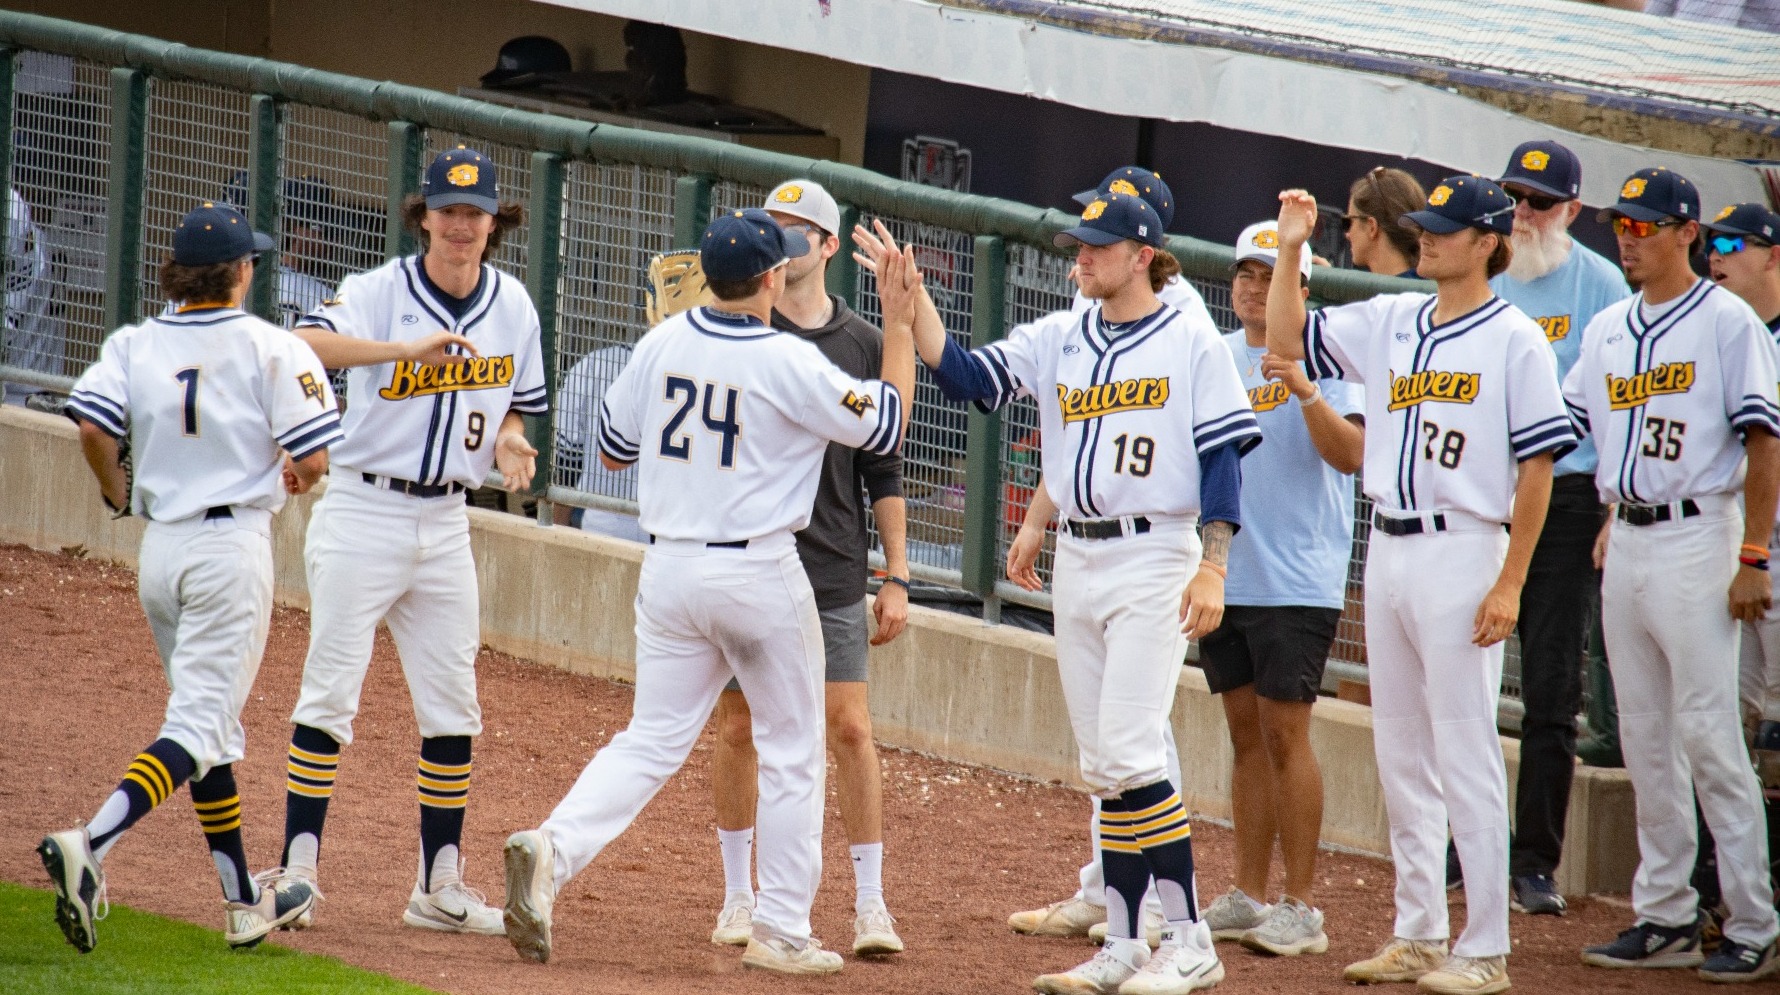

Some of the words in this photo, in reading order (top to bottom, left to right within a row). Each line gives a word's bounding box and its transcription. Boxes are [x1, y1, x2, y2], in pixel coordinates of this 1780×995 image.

[378, 354, 515, 401] Beavers
[1387, 368, 1482, 413] eavers
[1605, 360, 1697, 411] eaers
[172, 366, 201, 437] 1
[657, 372, 743, 471] 24
[465, 411, 485, 452] 9
[1111, 431, 1156, 479] 19
[1642, 416, 1687, 462] 35
